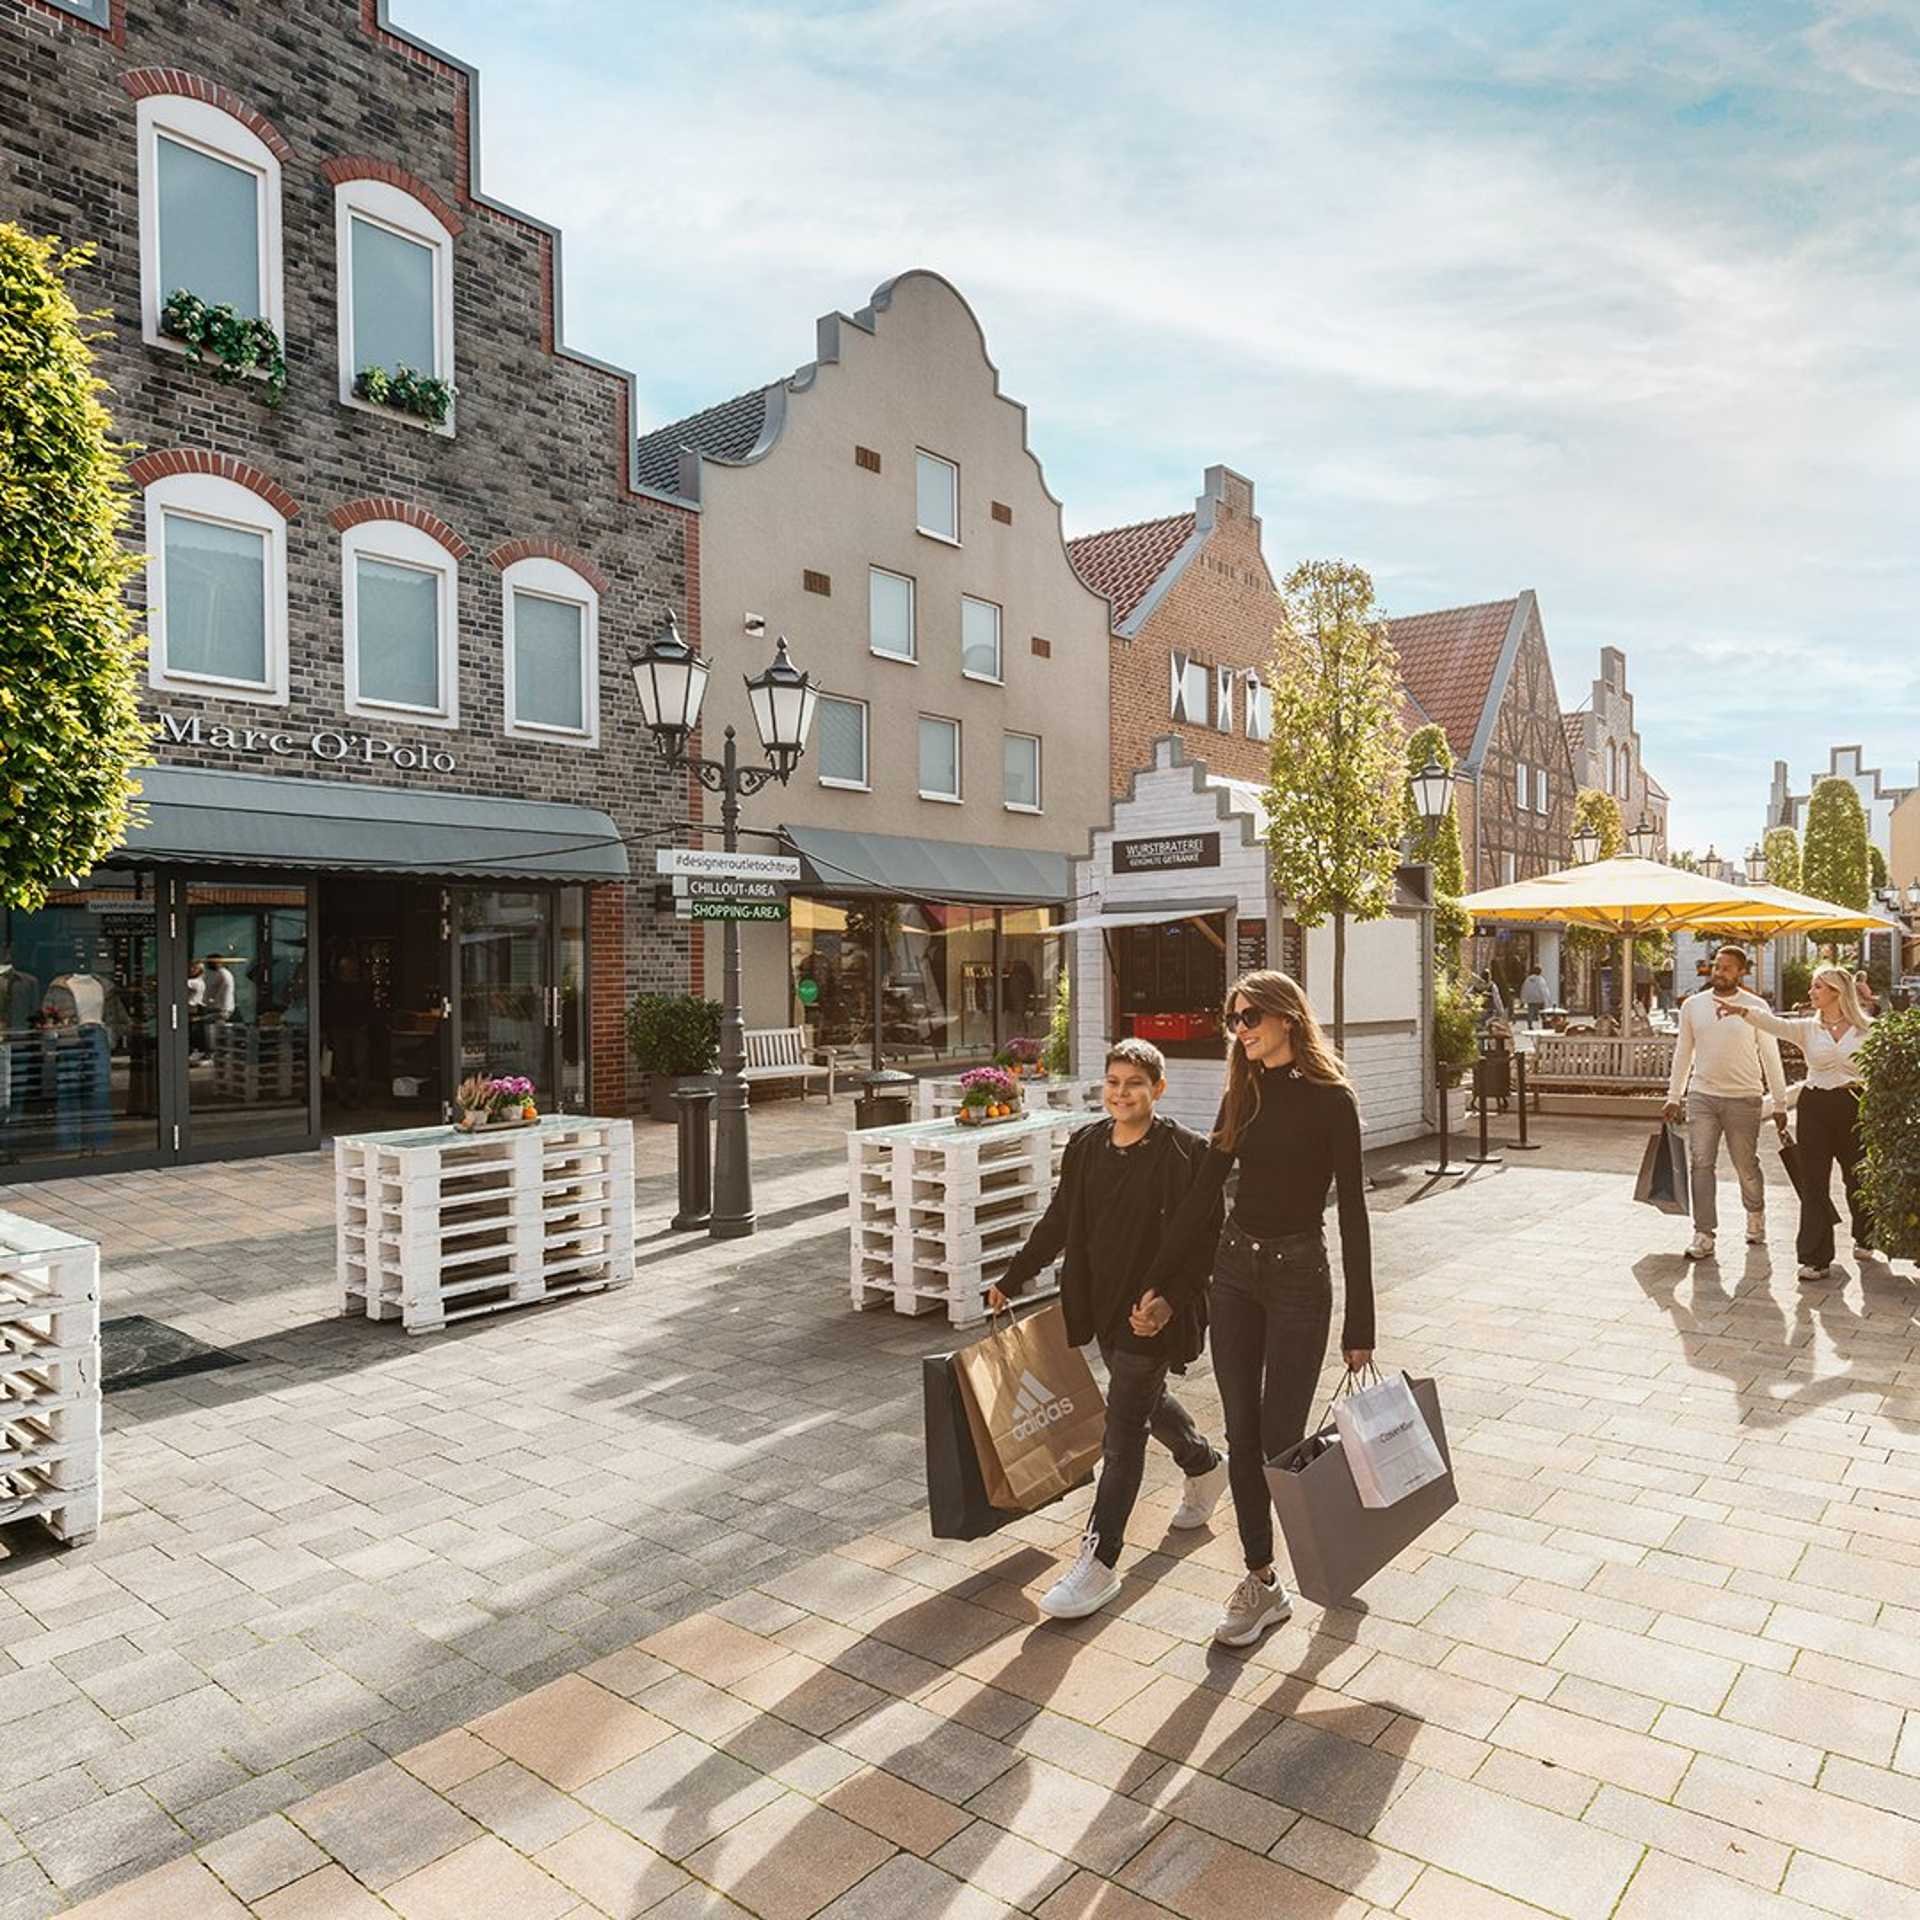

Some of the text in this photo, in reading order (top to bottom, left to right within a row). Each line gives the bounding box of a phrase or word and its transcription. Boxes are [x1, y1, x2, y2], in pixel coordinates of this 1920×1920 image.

[157, 713, 294, 753] Marc
[1125, 839, 1203, 857] WURSTBRATEREI
[690, 881, 776, 896] CHILLOUT-AREA
[693, 904, 781, 918] SHOPPING-AREA
[1012, 1397, 1075, 1441] adidas
